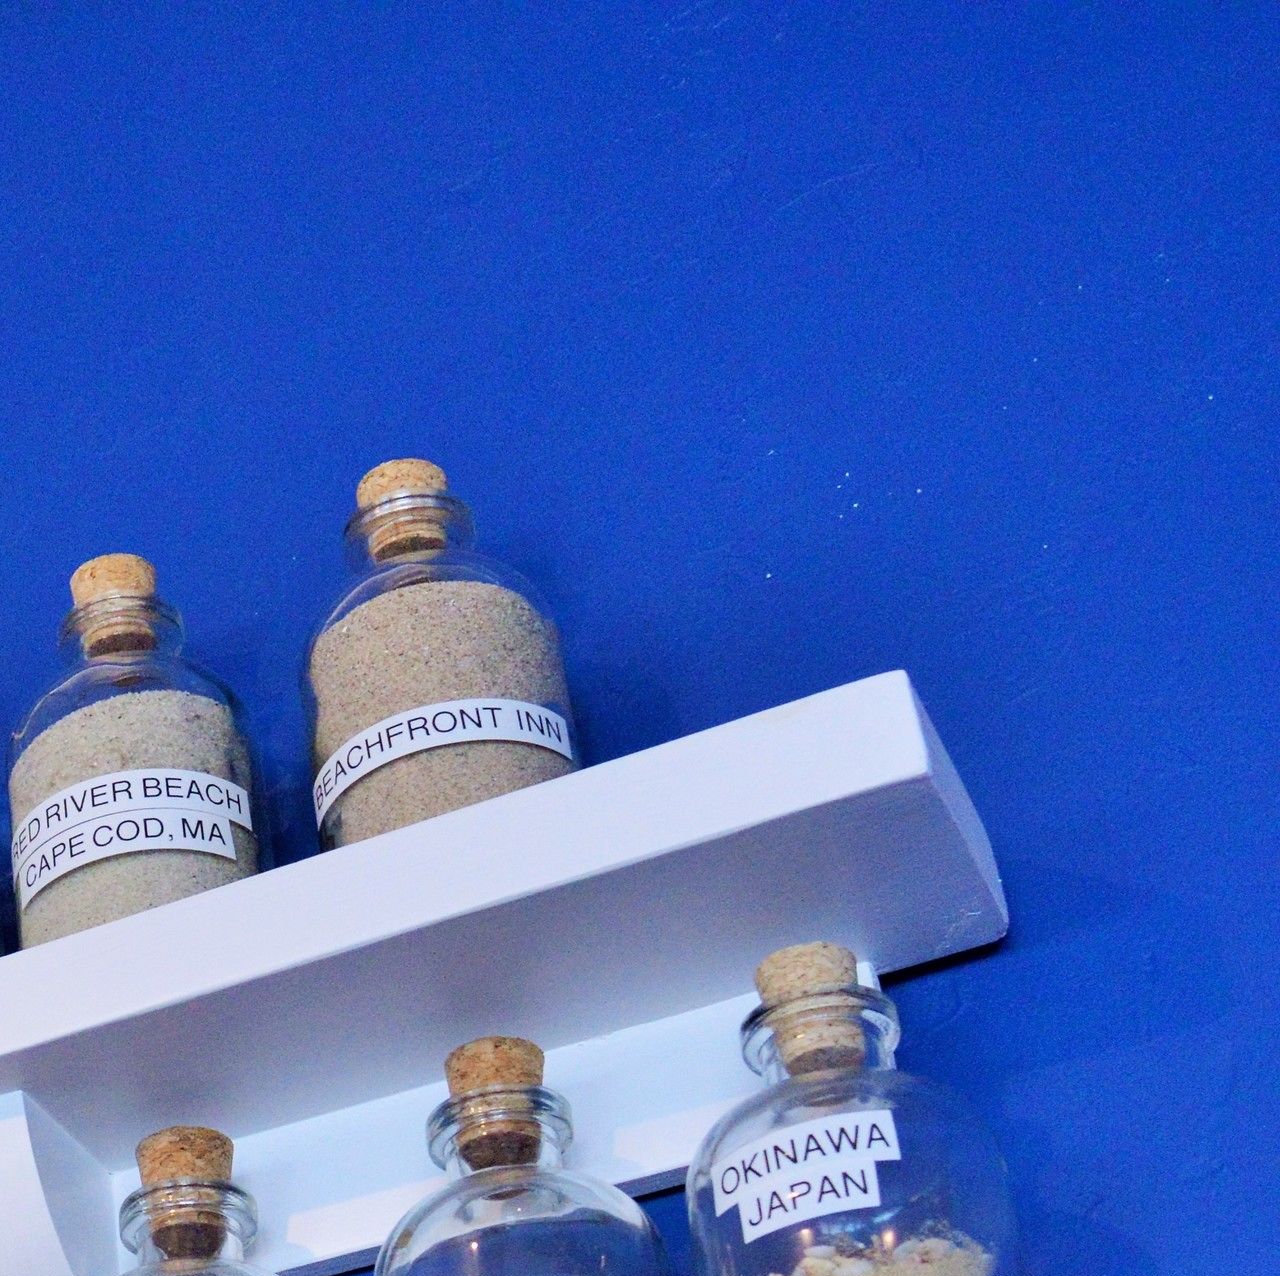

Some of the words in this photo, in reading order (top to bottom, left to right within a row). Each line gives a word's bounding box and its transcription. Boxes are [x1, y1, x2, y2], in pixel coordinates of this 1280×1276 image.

[315, 707, 502, 811] BEACHFRONT
[516, 709, 562, 744] INN
[45, 780, 133, 828] RIVER
[142, 777, 243, 814] BEACH
[25, 833, 86, 888] CAPE
[92, 817, 174, 847] COD,
[181, 817, 227, 846] MA
[721, 1123, 891, 1196] OKINAWA
[748, 1169, 869, 1228] JAPAN
